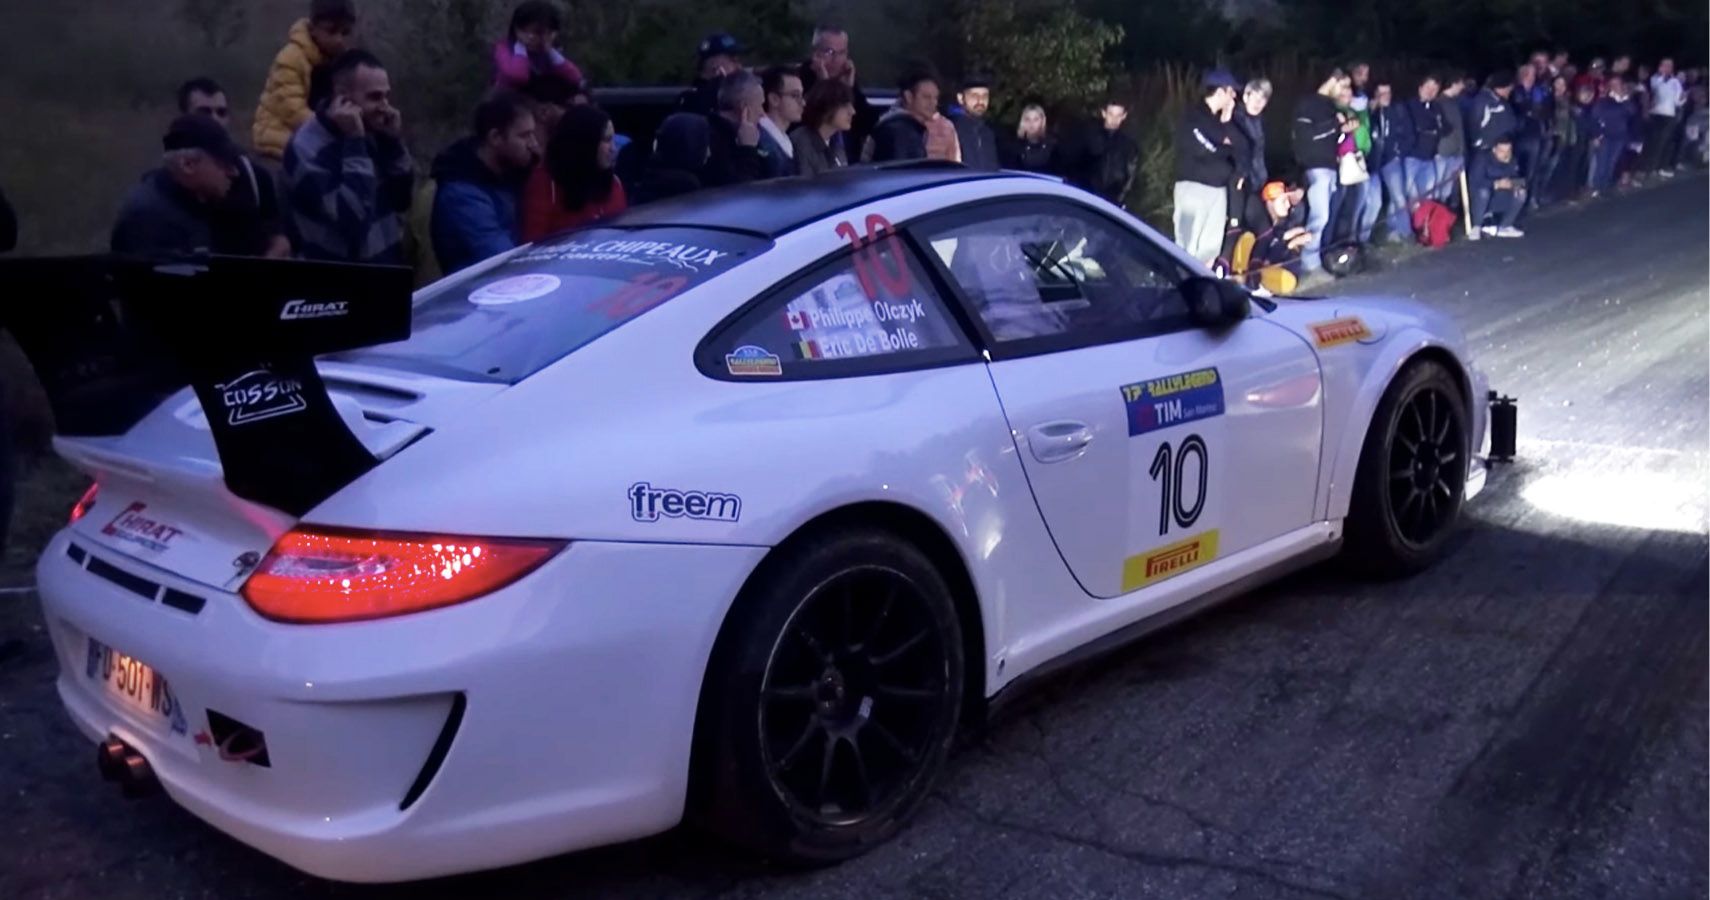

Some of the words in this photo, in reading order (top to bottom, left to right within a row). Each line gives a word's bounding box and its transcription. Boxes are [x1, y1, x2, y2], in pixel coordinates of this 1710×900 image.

[592, 240, 727, 266] CHIPEAUX
[835, 213, 912, 300] 10
[280, 300, 348, 319] CHIRAT
[809, 304, 873, 329] Philippe
[874, 299, 925, 324] Olczyk
[855, 334, 876, 355] De
[880, 329, 919, 350] Bolle
[223, 379, 302, 407] COSSON
[1154, 398, 1182, 424] TIM
[1149, 433, 1208, 536] 10
[629, 482, 741, 522] freem
[101, 501, 184, 543] CHIRAT
[1145, 541, 1200, 578] PIRELLI
